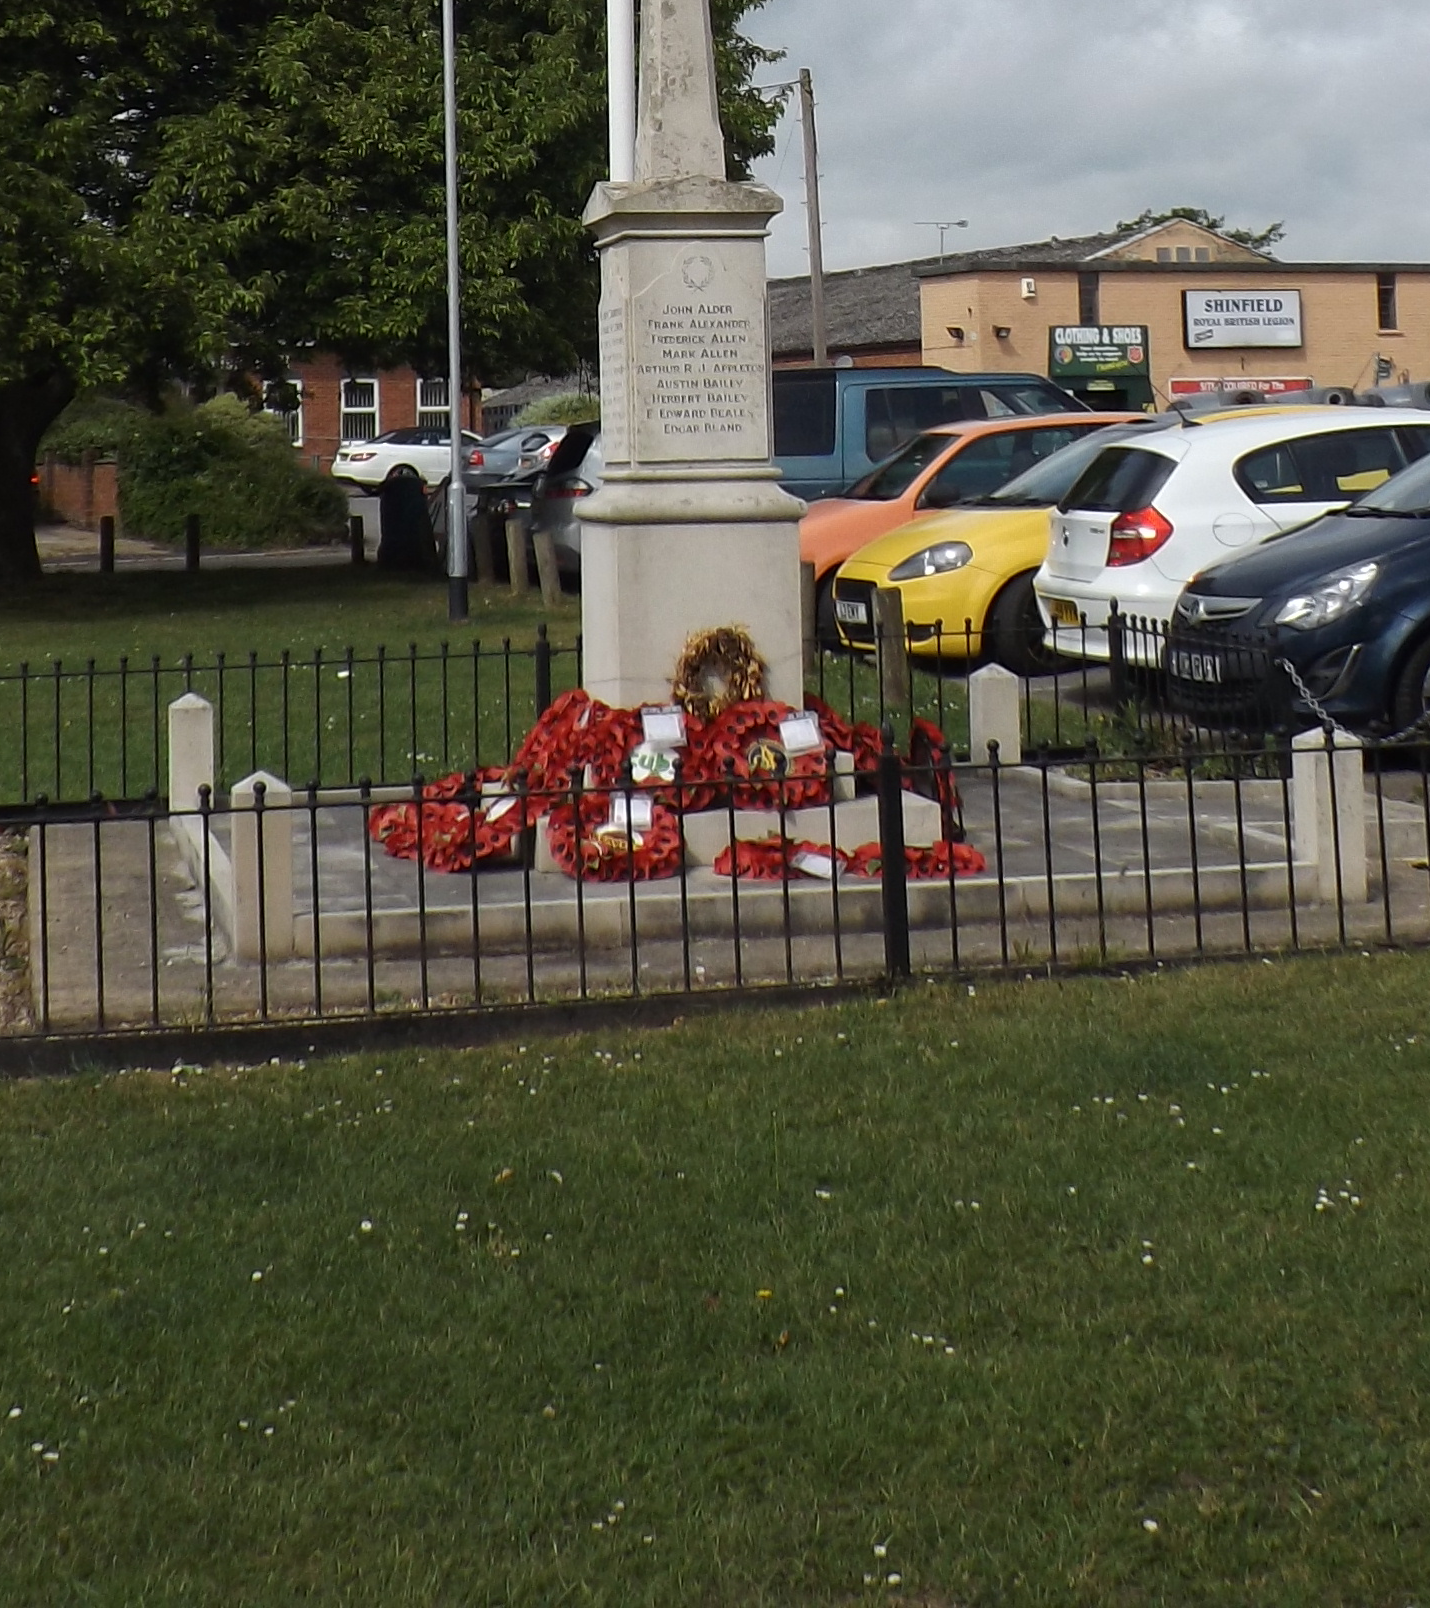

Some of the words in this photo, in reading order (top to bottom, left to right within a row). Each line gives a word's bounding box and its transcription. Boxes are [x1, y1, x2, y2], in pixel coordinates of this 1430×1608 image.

[662, 304, 693, 315] JOHN
[698, 304, 733, 314] ALDER
[1204, 298, 1283, 312] SHINFIELD
[648, 319, 684, 329] FRANK
[690, 319, 751, 329] ALEXANDER
[1193, 318, 1222, 327] ROYAL
[1224, 318, 1260, 327] BRITISH
[1262, 317, 1295, 326] LEGION
[652, 334, 705, 344] FREDERICK
[711, 334, 747, 344] ALLEN
[1055, 327, 1100, 345] CLOTHING
[1102, 327, 1110, 345] &
[1112, 327, 1142, 344] SHOES
[662, 349, 695, 359] MARK
[700, 348, 738, 359] ALLEN
[637, 364, 680, 375] ARTHUR
[657, 379, 699, 389] AUSTIN
[703, 378, 743, 389] BAILEY
[652, 394, 701, 404] HERBERT
[707, 393, 748, 403] BAILEY
[659, 408, 707, 419] EDWARD
[664, 423, 700, 434] EDGAR
